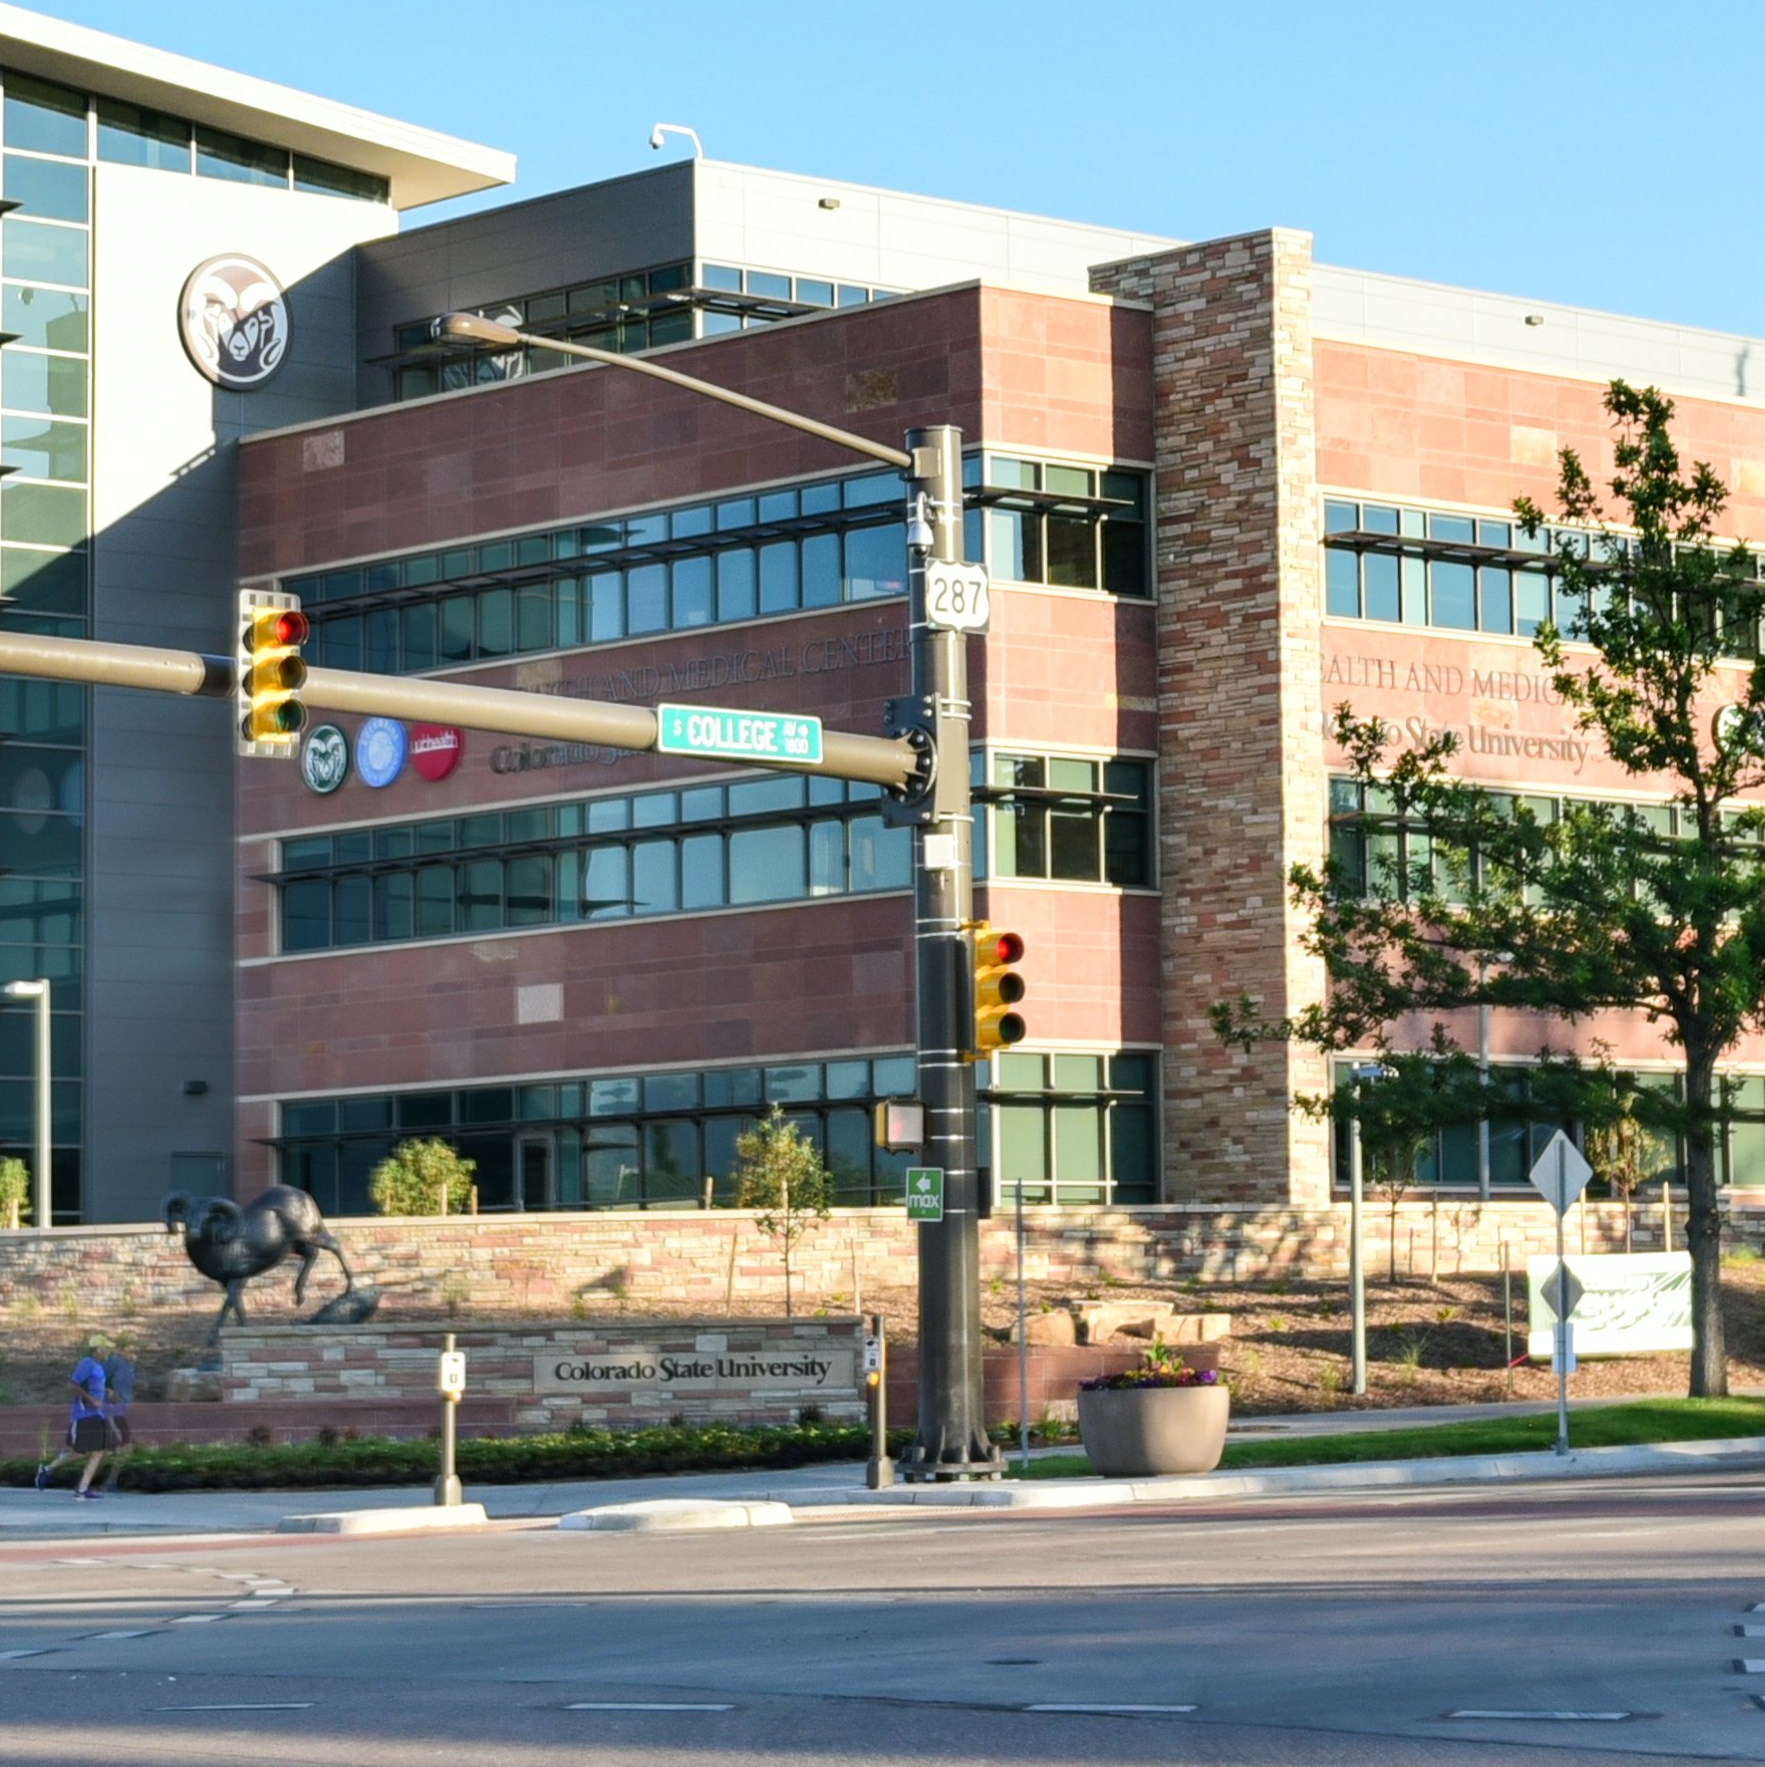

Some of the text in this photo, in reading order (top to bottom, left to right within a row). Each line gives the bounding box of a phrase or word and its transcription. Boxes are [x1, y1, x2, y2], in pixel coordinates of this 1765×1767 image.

[933, 577, 982, 615] 287
[602, 665, 661, 702] AND
[668, 645, 796, 694] MEDICAL
[1404, 661, 1464, 696] AND
[672, 714, 798, 753] S COLLEGE AV
[1468, 723, 1589, 776] University
[908, 1194, 940, 1209] max
[554, 1354, 833, 1385] Colorado State University
